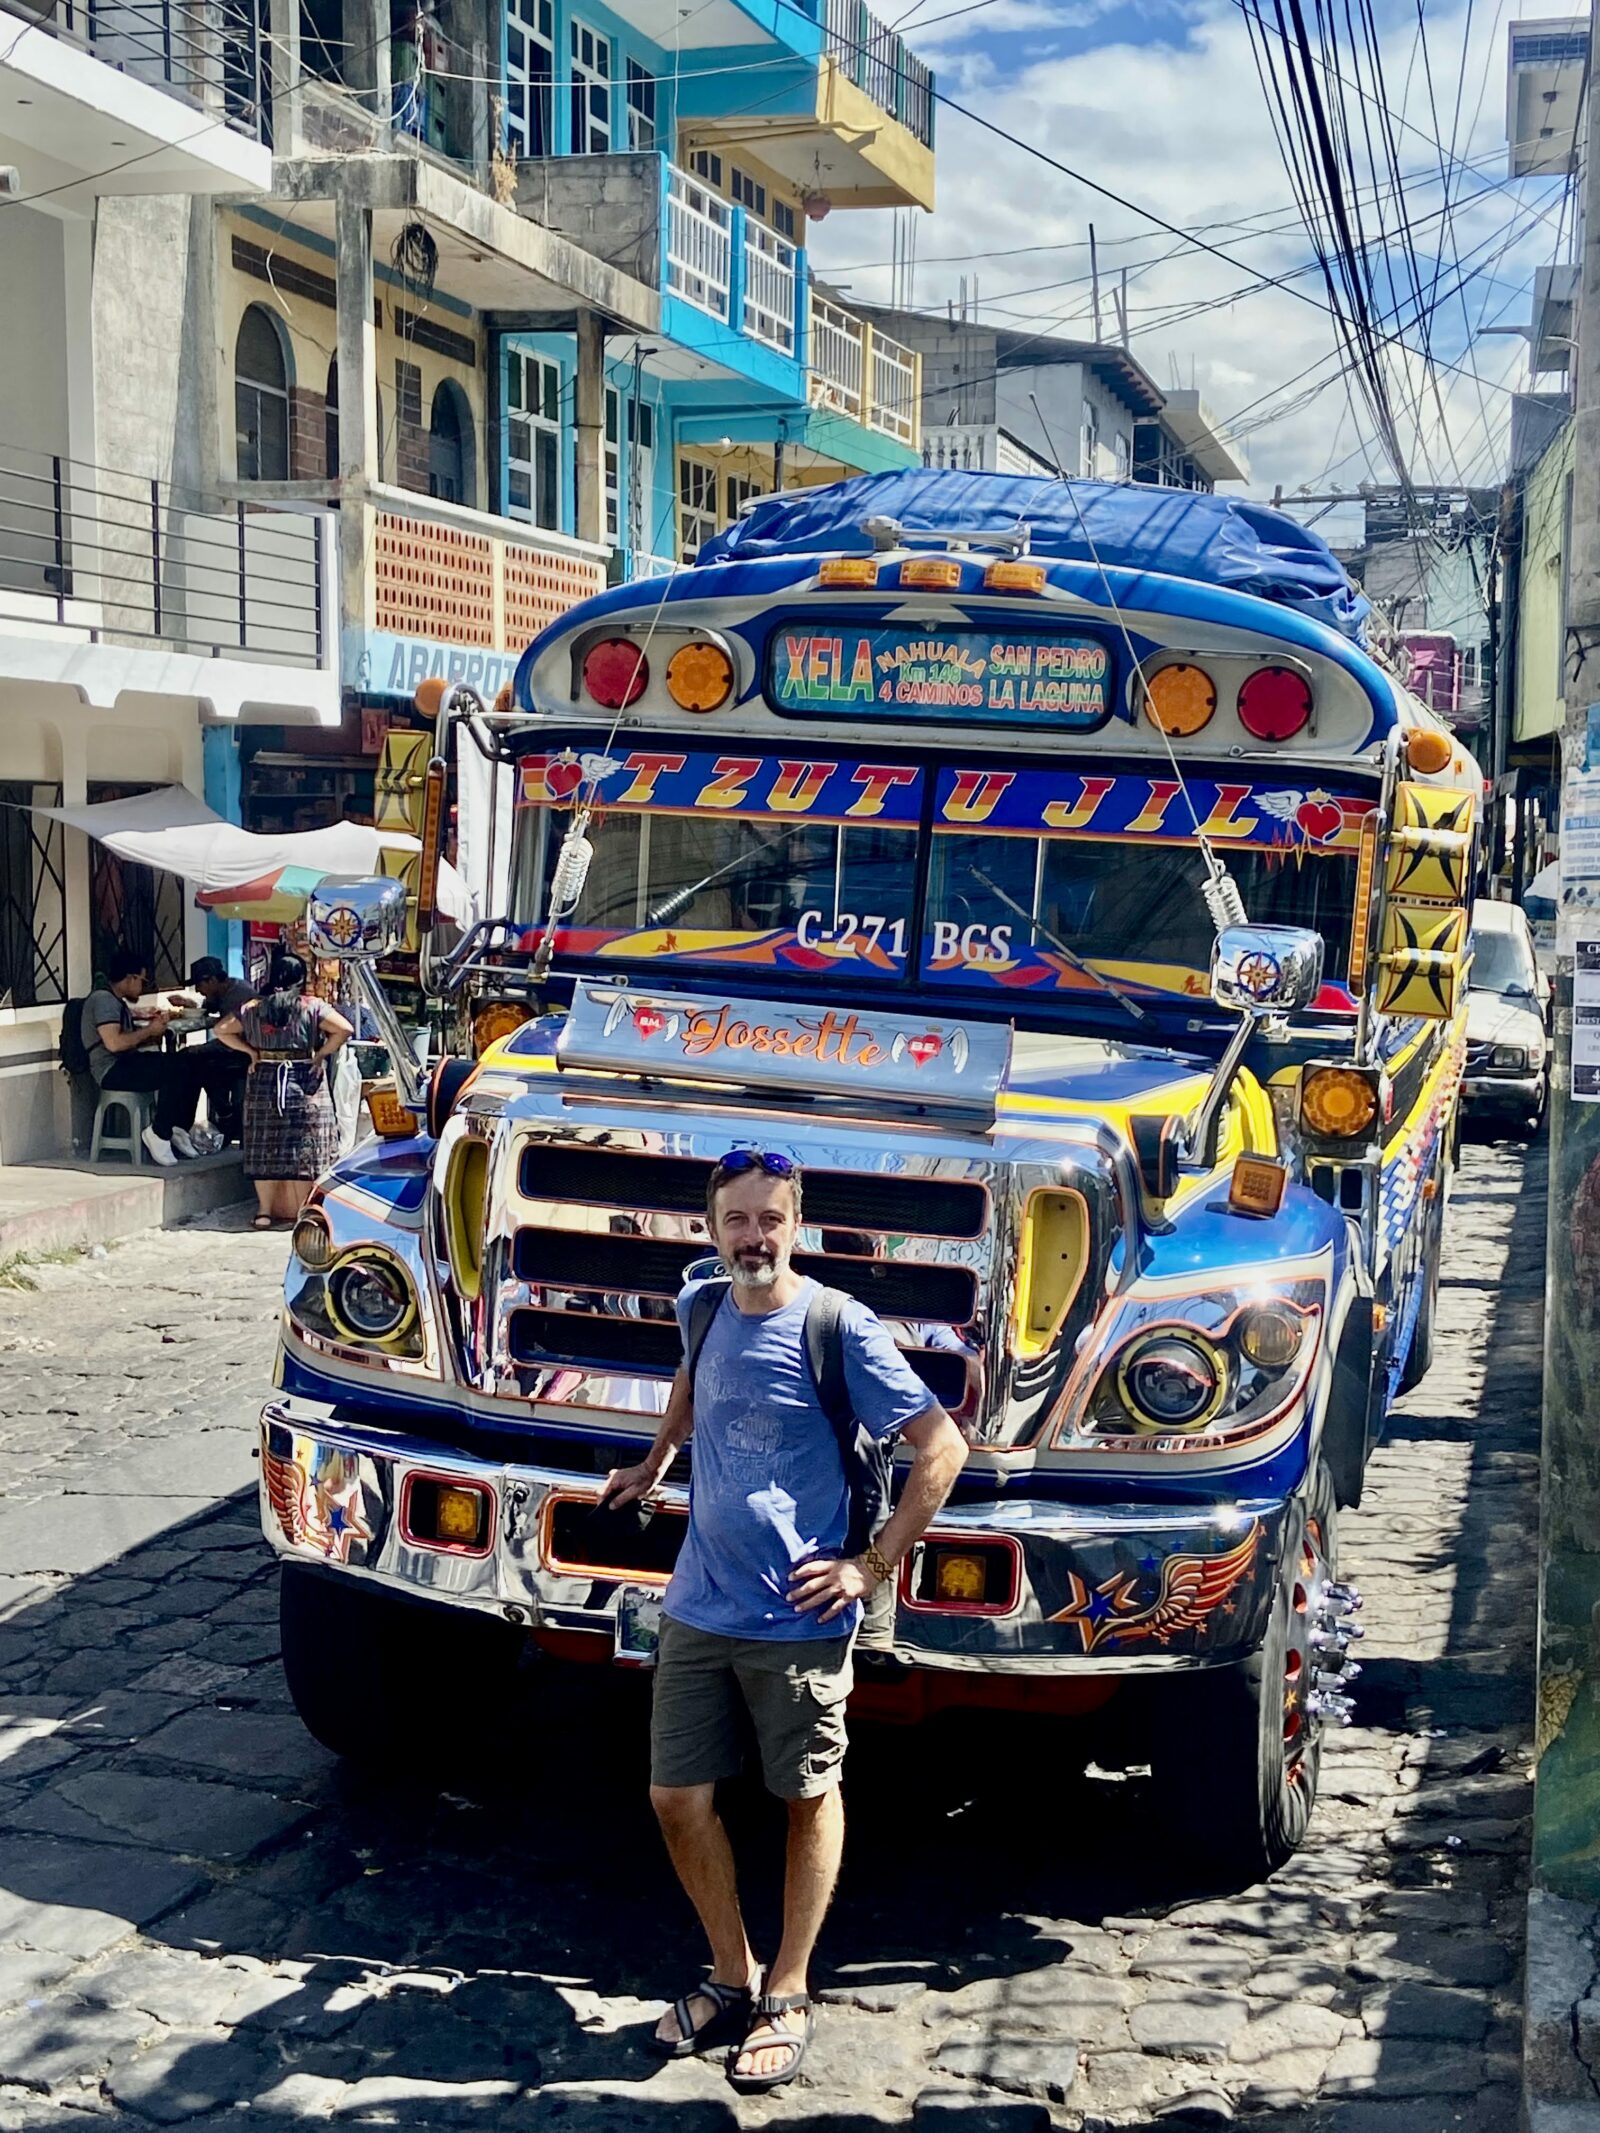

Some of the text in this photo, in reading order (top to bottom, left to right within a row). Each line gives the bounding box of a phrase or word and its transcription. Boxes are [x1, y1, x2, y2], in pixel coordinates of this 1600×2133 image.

[781, 636, 874, 702] XELA
[876, 641, 987, 680] NAHUALA
[930, 664, 961, 683] 148
[989, 645, 1106, 679] SAN PEDRO
[879, 682, 983, 707] 4 CAMINOS
[988, 679, 1105, 713] LA LAGUNA
[797, 910, 1013, 964] C-271 BGS
[818, 1290, 833, 1361] ATERPROO
